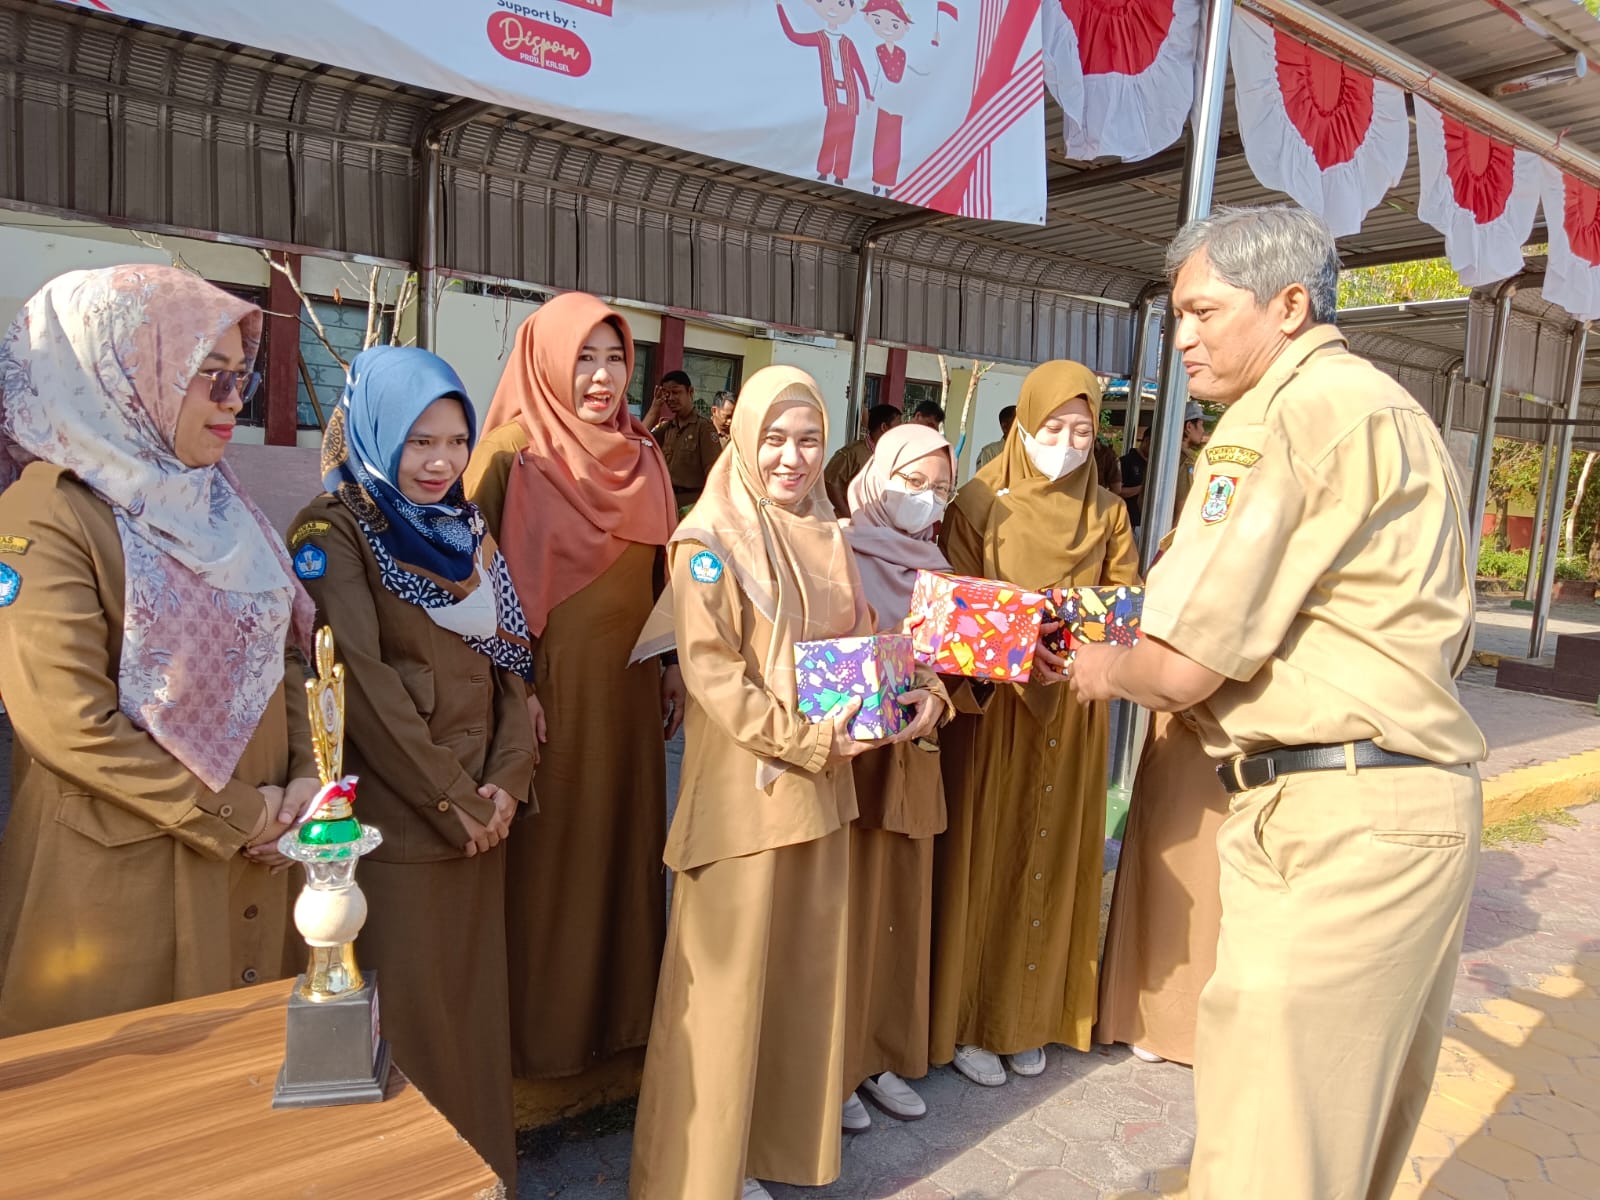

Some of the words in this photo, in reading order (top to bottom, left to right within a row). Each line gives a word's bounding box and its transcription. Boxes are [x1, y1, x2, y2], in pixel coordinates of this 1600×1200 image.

[497, 0, 551, 20] Support
[553, 8, 569, 28] by
[499, 17, 580, 67] Dispora
[545, 60, 570, 73] KALSEL
